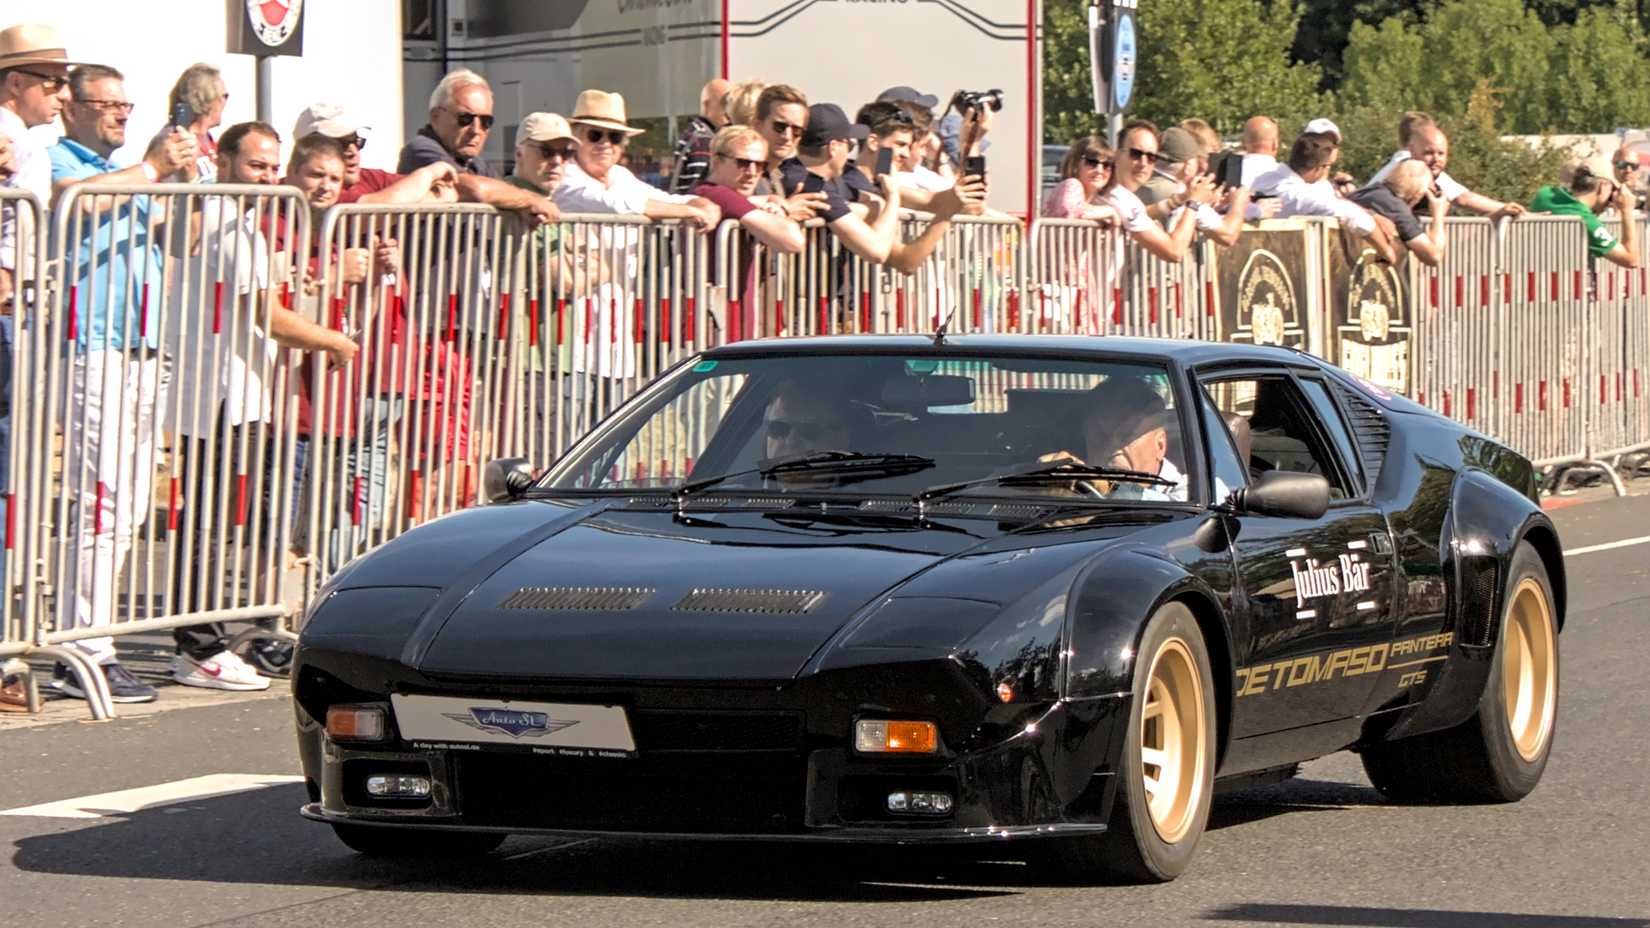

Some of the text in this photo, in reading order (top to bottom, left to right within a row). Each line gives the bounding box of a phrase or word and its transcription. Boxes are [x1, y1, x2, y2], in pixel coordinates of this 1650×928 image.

[1290, 553, 1370, 608] Julius Bär
[1390, 632, 1455, 656] PANTERA
[1398, 670, 1428, 688] GTS
[482, 711, 516, 725] Auto
